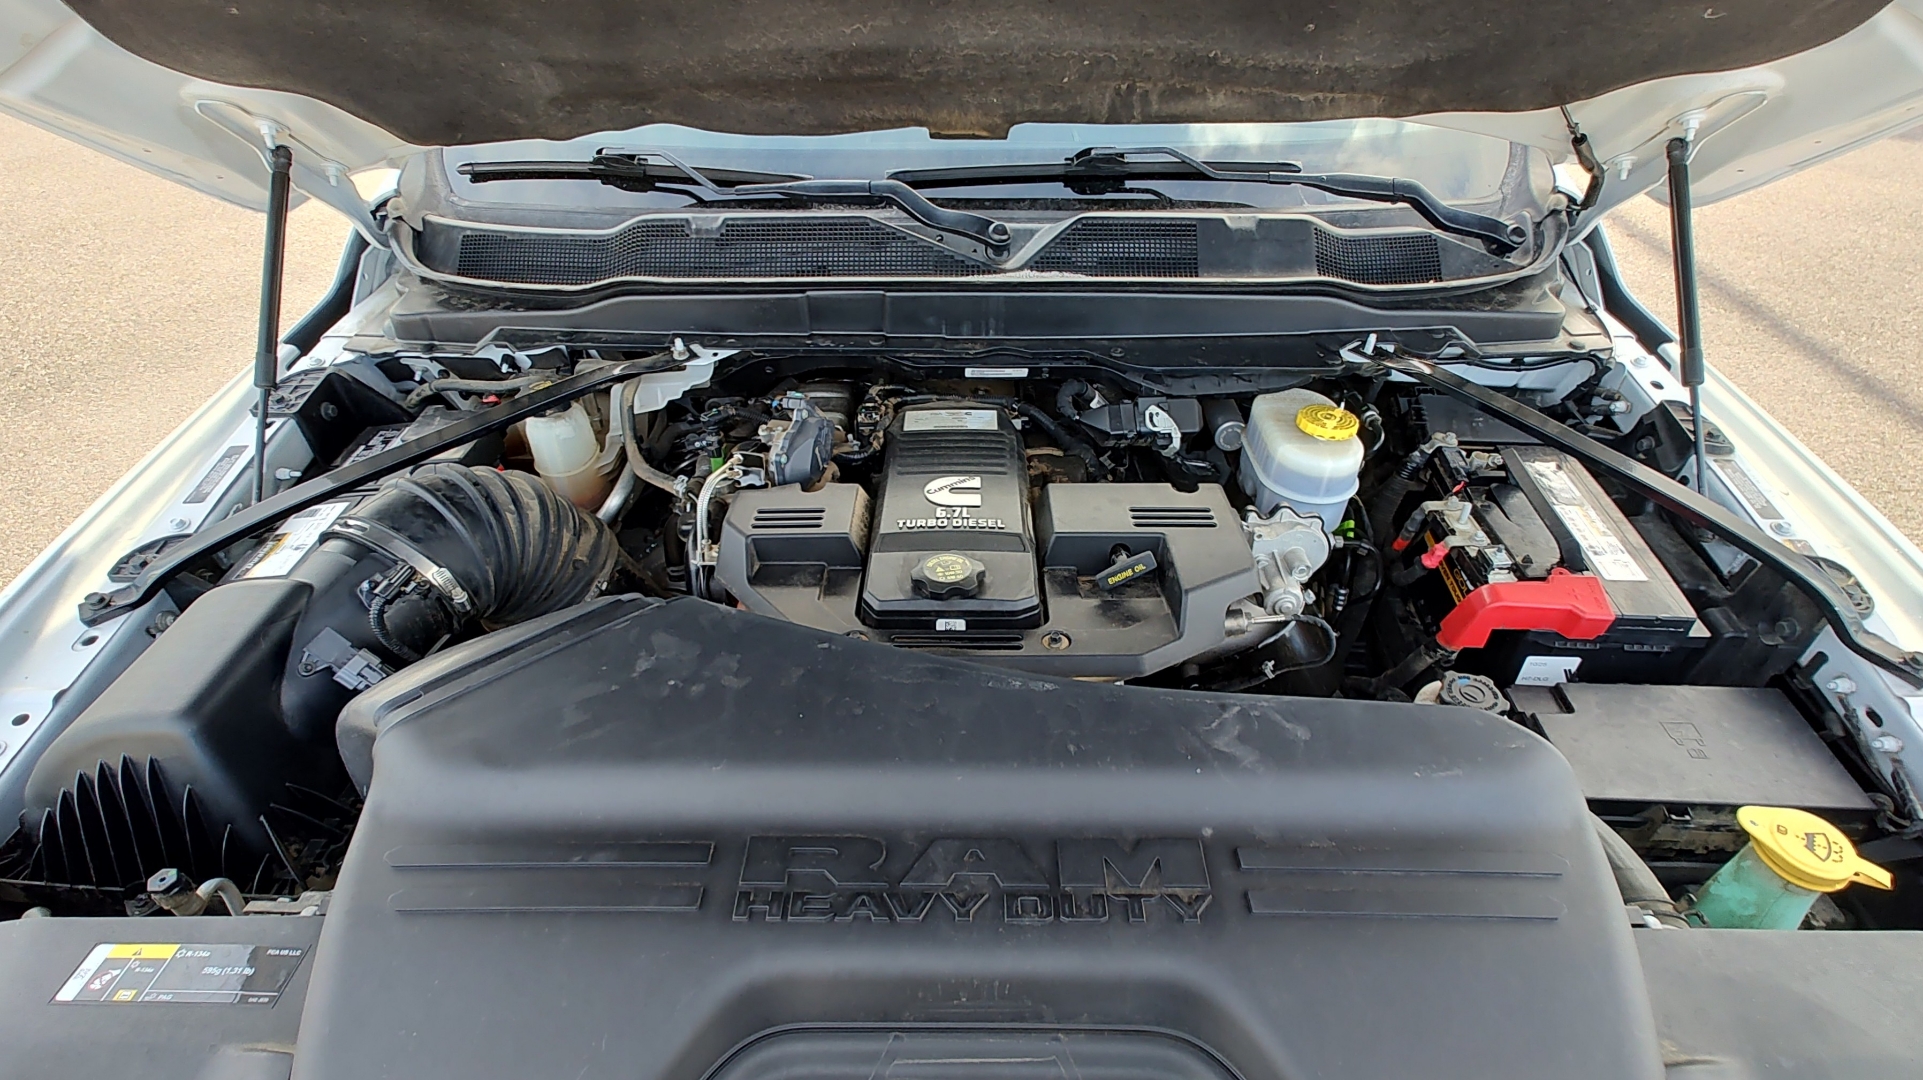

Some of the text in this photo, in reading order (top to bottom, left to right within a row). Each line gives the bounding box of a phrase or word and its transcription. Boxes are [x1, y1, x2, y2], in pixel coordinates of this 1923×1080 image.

[926, 476, 976, 495] Cummins
[935, 507, 971, 519] 6.7L
[897, 518, 1006, 529] TURBO DIESEL
[1107, 563, 1147, 585] ENGINE OIL
[1453, 568, 1468, 597] GOL
[739, 834, 1211, 888] RAM
[733, 890, 1213, 924] HEAVY DUTY
[185, 949, 211, 958] R-134a
[201, 966, 256, 976] 595g (1.31 lb)
